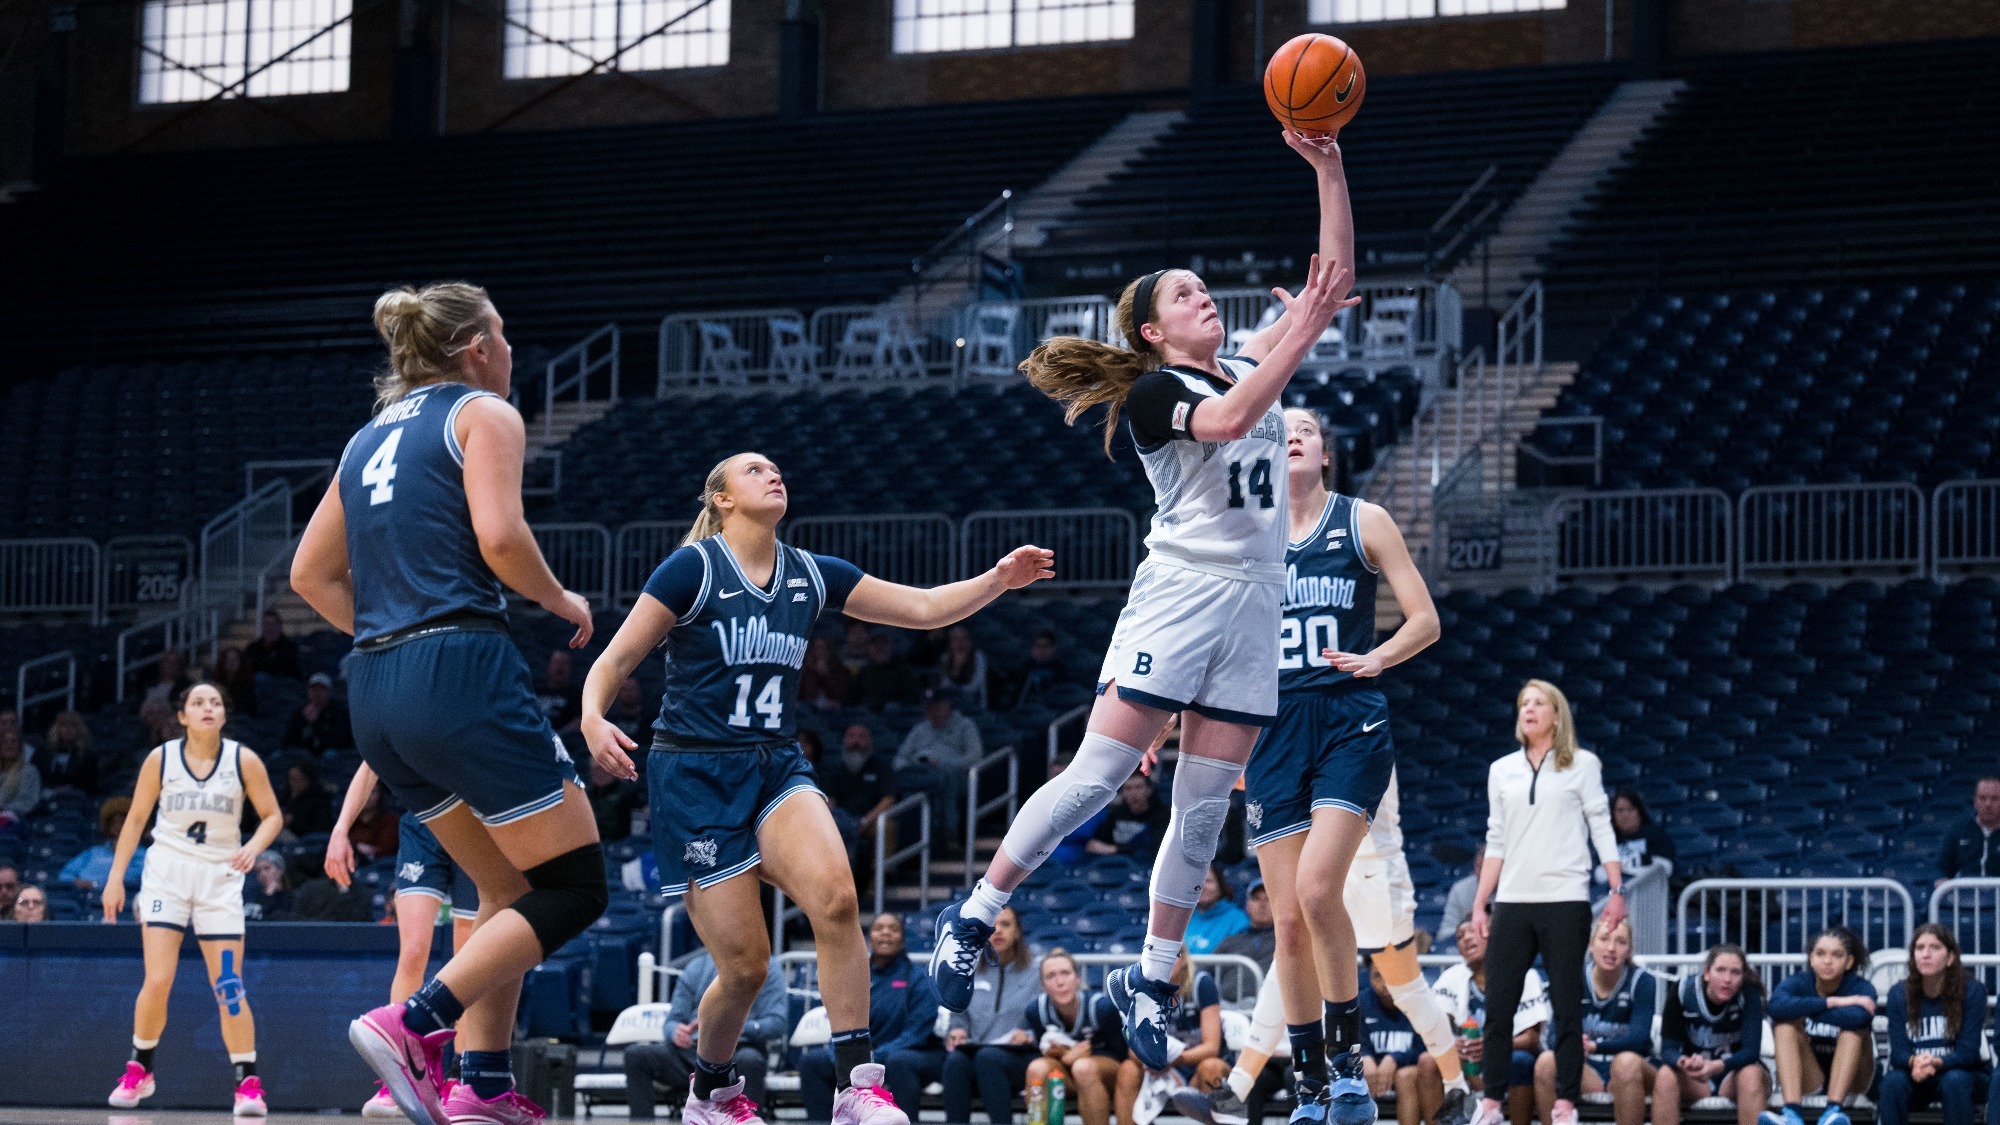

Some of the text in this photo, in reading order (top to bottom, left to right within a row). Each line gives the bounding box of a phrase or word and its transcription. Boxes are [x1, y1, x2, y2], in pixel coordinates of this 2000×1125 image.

[1202, 409, 1286, 462] BLER
[362, 426, 404, 506] 4
[1228, 459, 1275, 509] 14
[1450, 540, 1498, 568] 207
[137, 574, 178, 600] 205
[1284, 563, 1356, 610] lanova
[1132, 651, 1153, 676] B
[1278, 614, 1339, 670] 20
[728, 673, 783, 729] 14
[187, 821, 207, 843] 4
[152, 900, 163, 912] B
